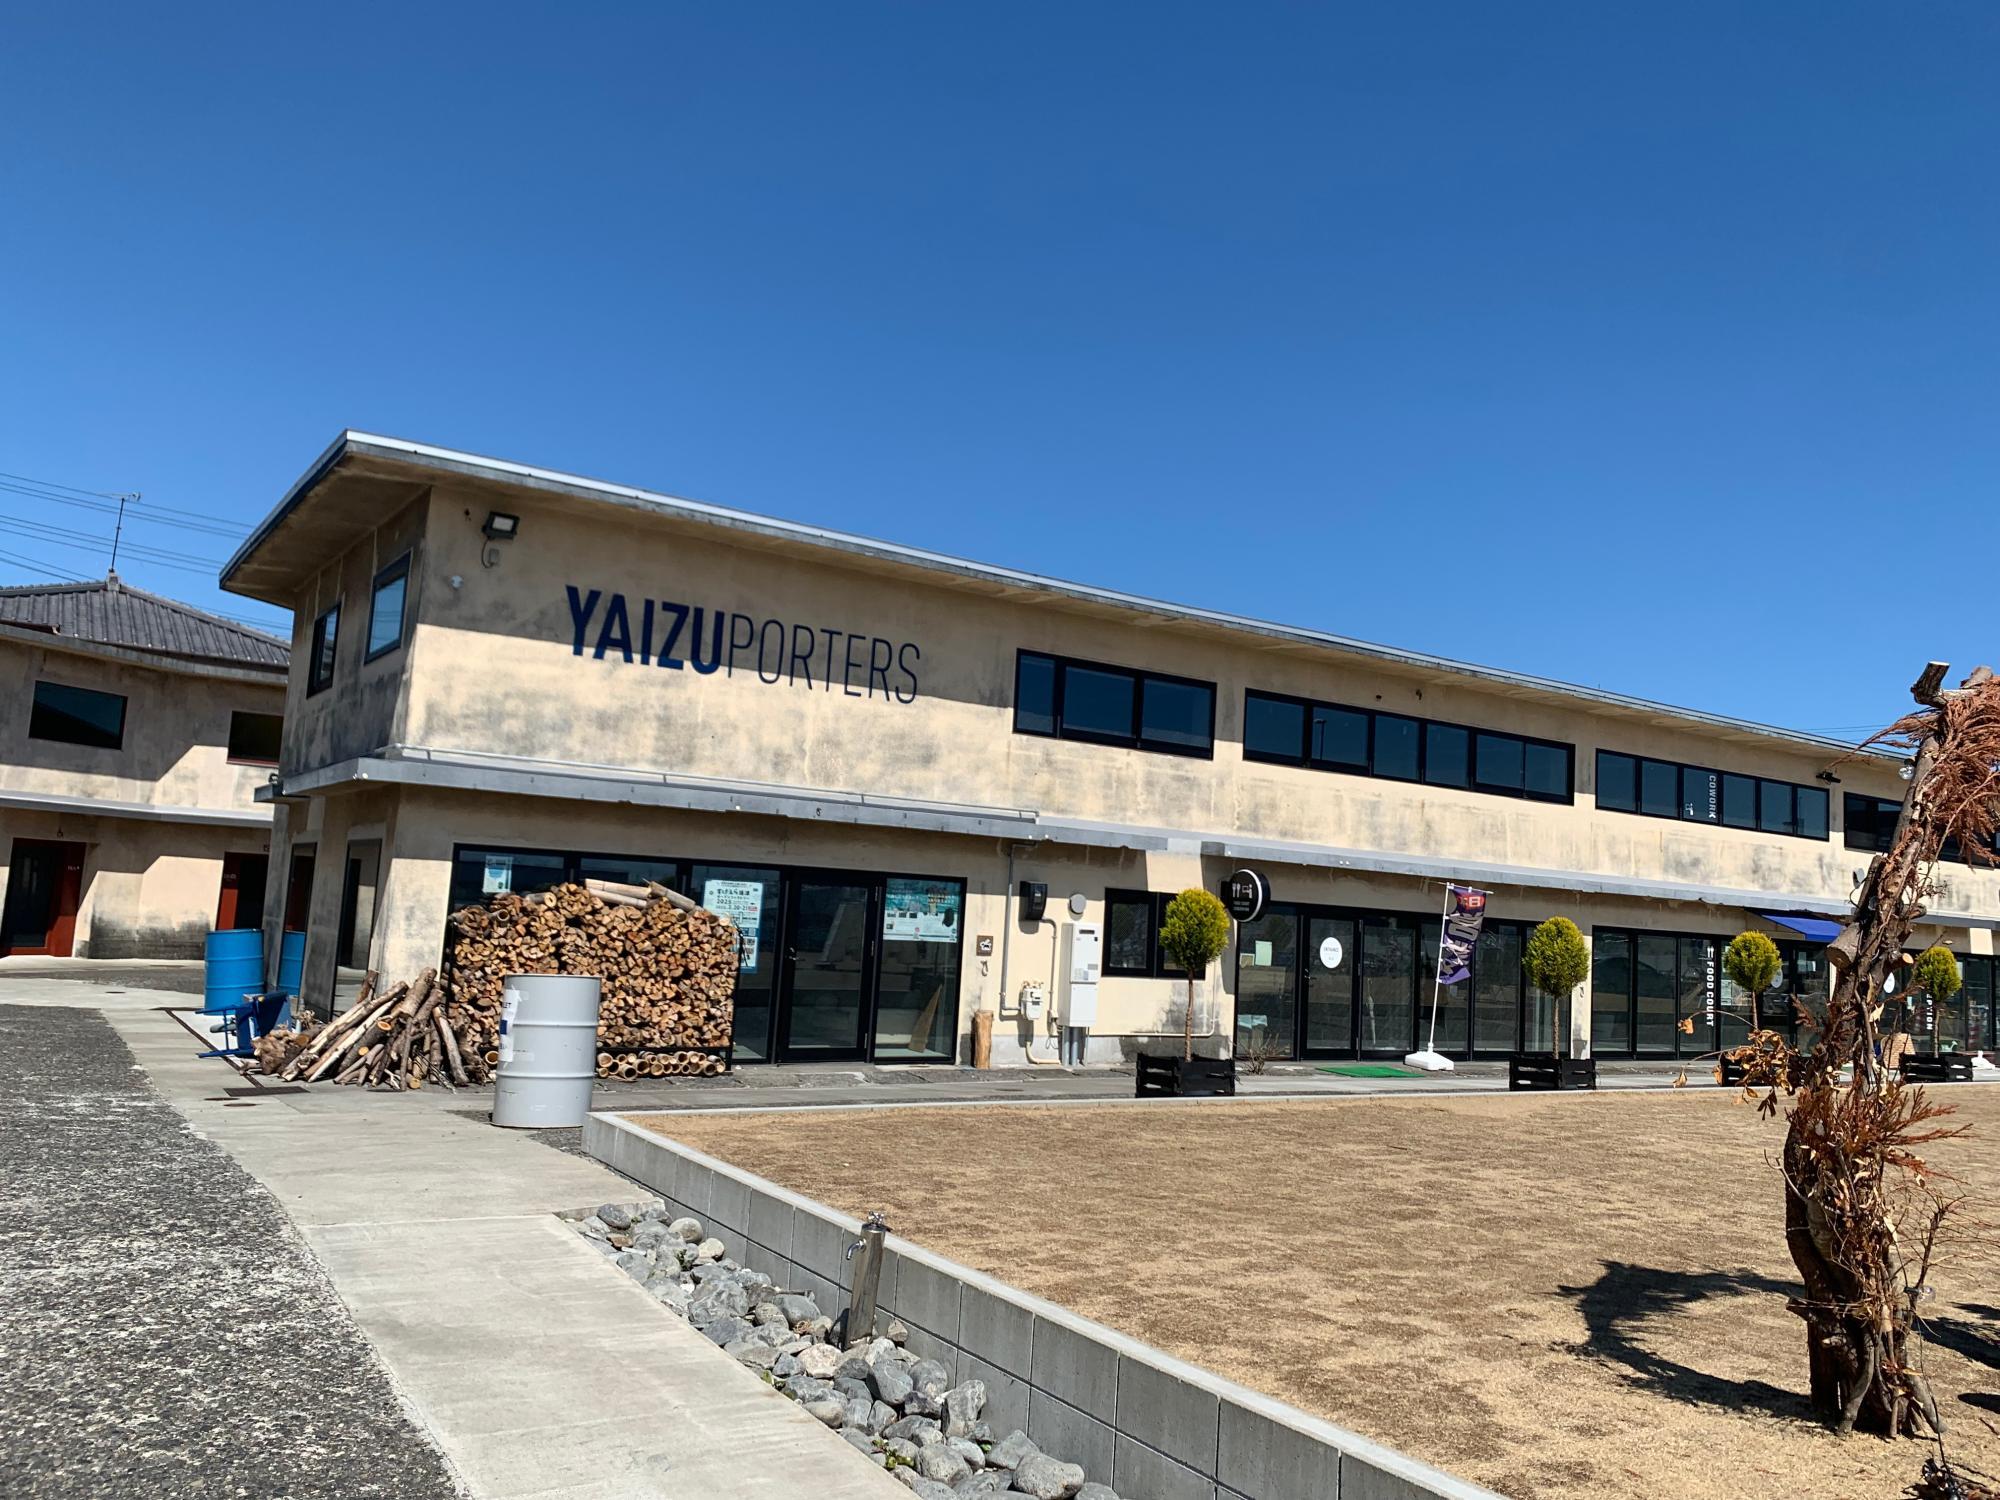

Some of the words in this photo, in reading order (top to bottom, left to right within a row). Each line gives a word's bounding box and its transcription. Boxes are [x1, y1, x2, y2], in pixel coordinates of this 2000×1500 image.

[1708, 775, 1717, 819] COWORK
[1706, 961, 1715, 989] FOOD
[1706, 991, 1715, 1027] COURT
